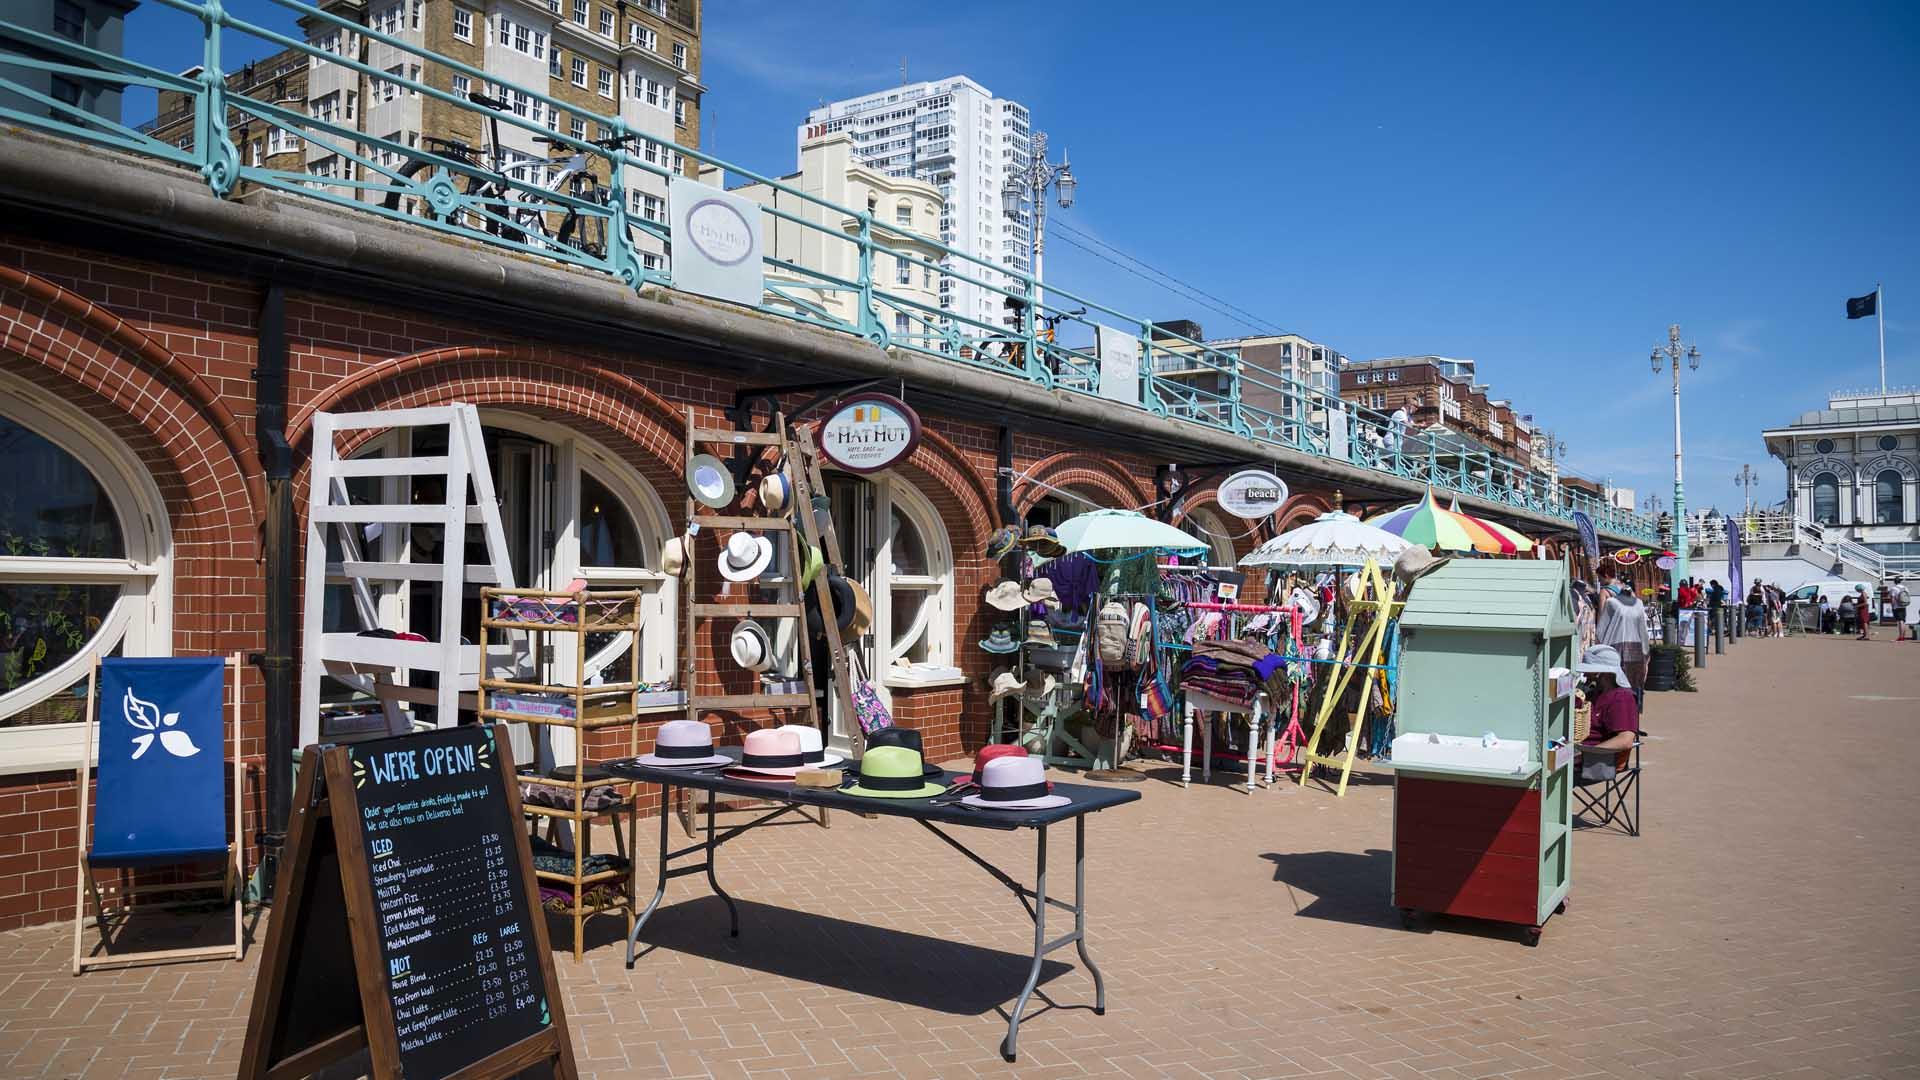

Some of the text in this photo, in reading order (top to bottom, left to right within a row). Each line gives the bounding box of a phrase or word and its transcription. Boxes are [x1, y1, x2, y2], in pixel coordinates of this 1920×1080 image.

[838, 424, 870, 444] HAT
[873, 423, 908, 442] HUT
[1248, 488, 1276, 498] beach
[370, 744, 476, 785] WE'RE OPEN!
[364, 806, 381, 819] Order
[383, 805, 395, 818] your
[397, 802, 419, 815] favourite
[437, 793, 457, 807] freshly
[457, 790, 471, 800] made
[471, 788, 478, 798] to
[479, 784, 489, 800] go!
[366, 802, 464, 832] We are also now on Deliveroo too!
[371, 838, 393, 855] ICED
[372, 833, 499, 873] Iced Chai £3.50
[374, 845, 502, 887] Strawberry Lemonade £3.25
[380, 897, 404, 911] Unicorn
[488, 869, 508, 882] £3.50
[383, 880, 508, 924] Lemon & Honey £3.25
[384, 890, 511, 937] Iced Matcha Latte £3.75
[387, 901, 513, 951] Matcha Lemonade £3.75
[472, 922, 520, 946] REG LARGE
[390, 955, 411, 976] HOT
[392, 979, 409, 990] House
[410, 972, 427, 985] Blend
[504, 940, 523, 953] £2.50
[393, 995, 405, 1006] Tea
[478, 961, 498, 976] £2.50
[506, 952, 525, 967] £2.75
[396, 968, 528, 1020] Chai Latte £3.50 £3.75
[397, 1023, 411, 1037] Earl
[412, 1020, 427, 1032] Grey
[442, 1007, 459, 1020] Latte
[401, 1038, 425, 1053] Matcha
[425, 1031, 443, 1043] Latte
[516, 994, 535, 1009] £4.00
